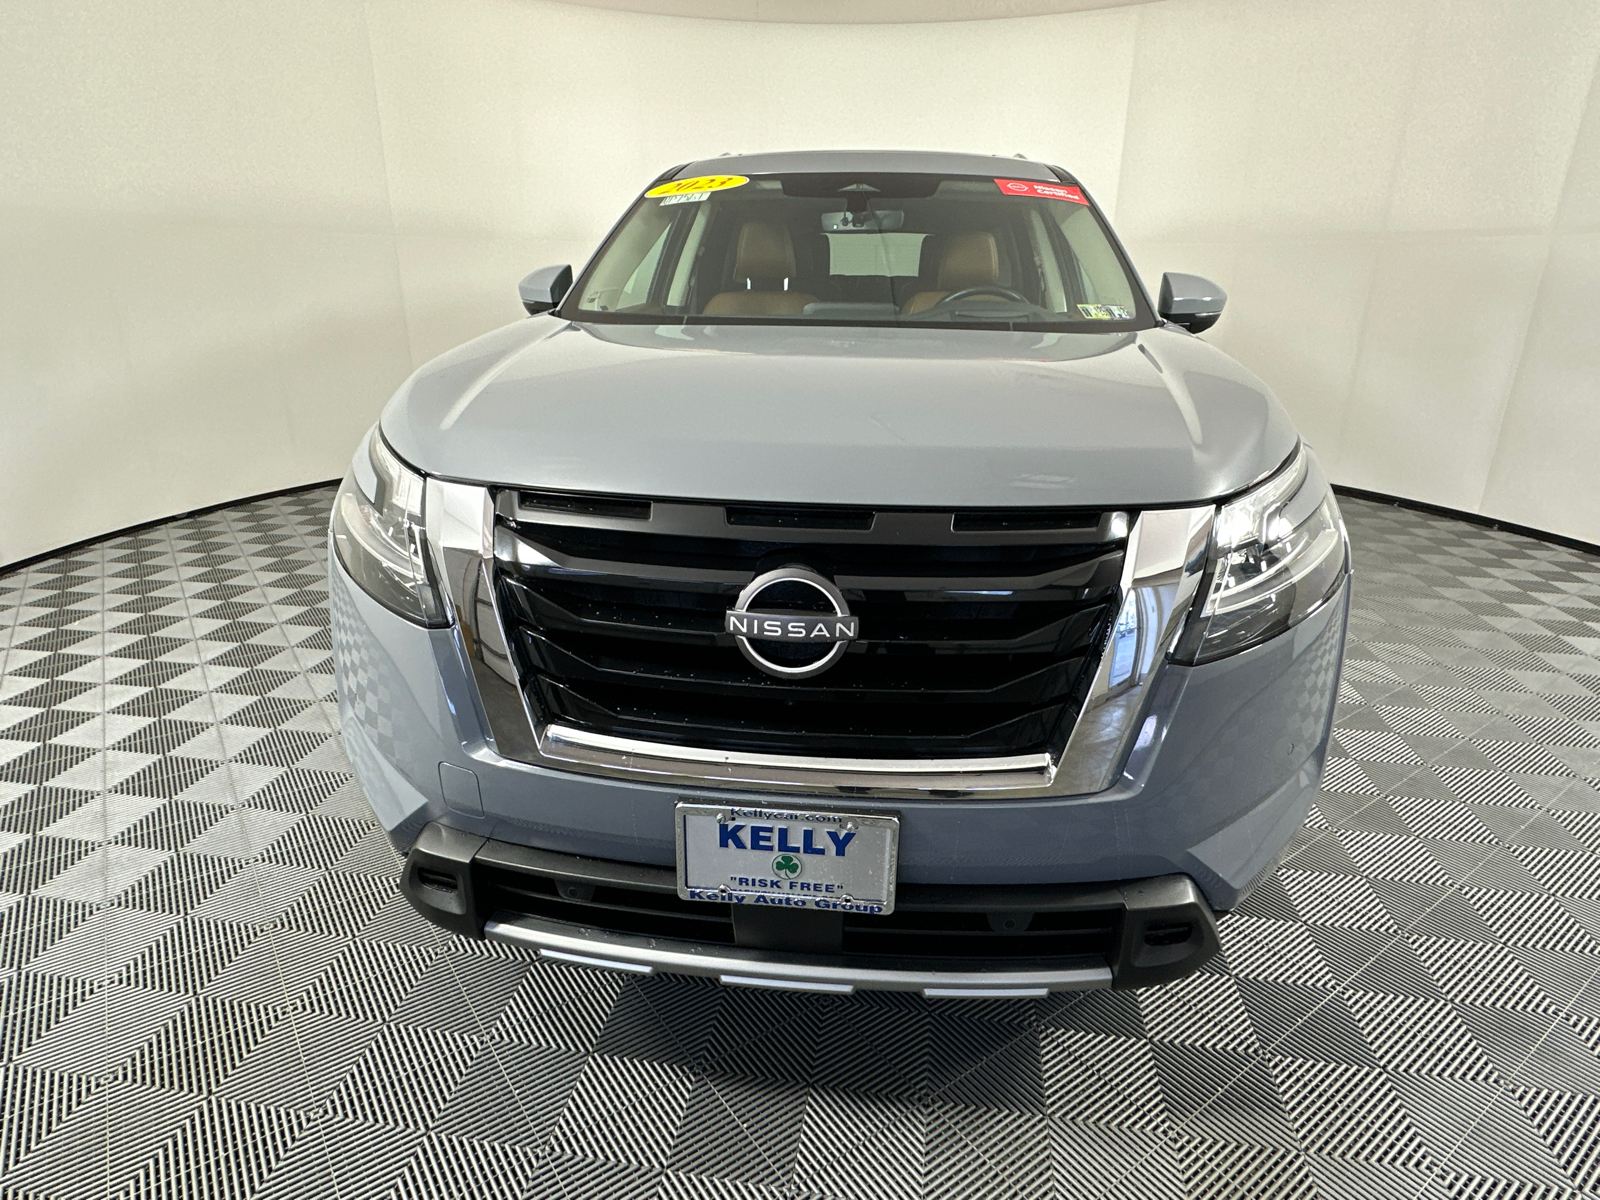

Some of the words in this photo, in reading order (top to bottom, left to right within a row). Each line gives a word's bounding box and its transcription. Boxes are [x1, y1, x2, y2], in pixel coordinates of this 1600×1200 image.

[656, 177, 734, 196] 2023
[1033, 184, 1068, 194] Nissan
[1037, 189, 1080, 200] Certified
[729, 616, 855, 638] NISSAN
[730, 807, 843, 823] Kellycar.com
[718, 823, 856, 857] KELLY
[730, 876, 782, 890] "RISK
[789, 881, 844, 893] FREE"
[689, 889, 748, 905] Kelly
[752, 894, 807, 908] Auto
[814, 897, 883, 915] Group
